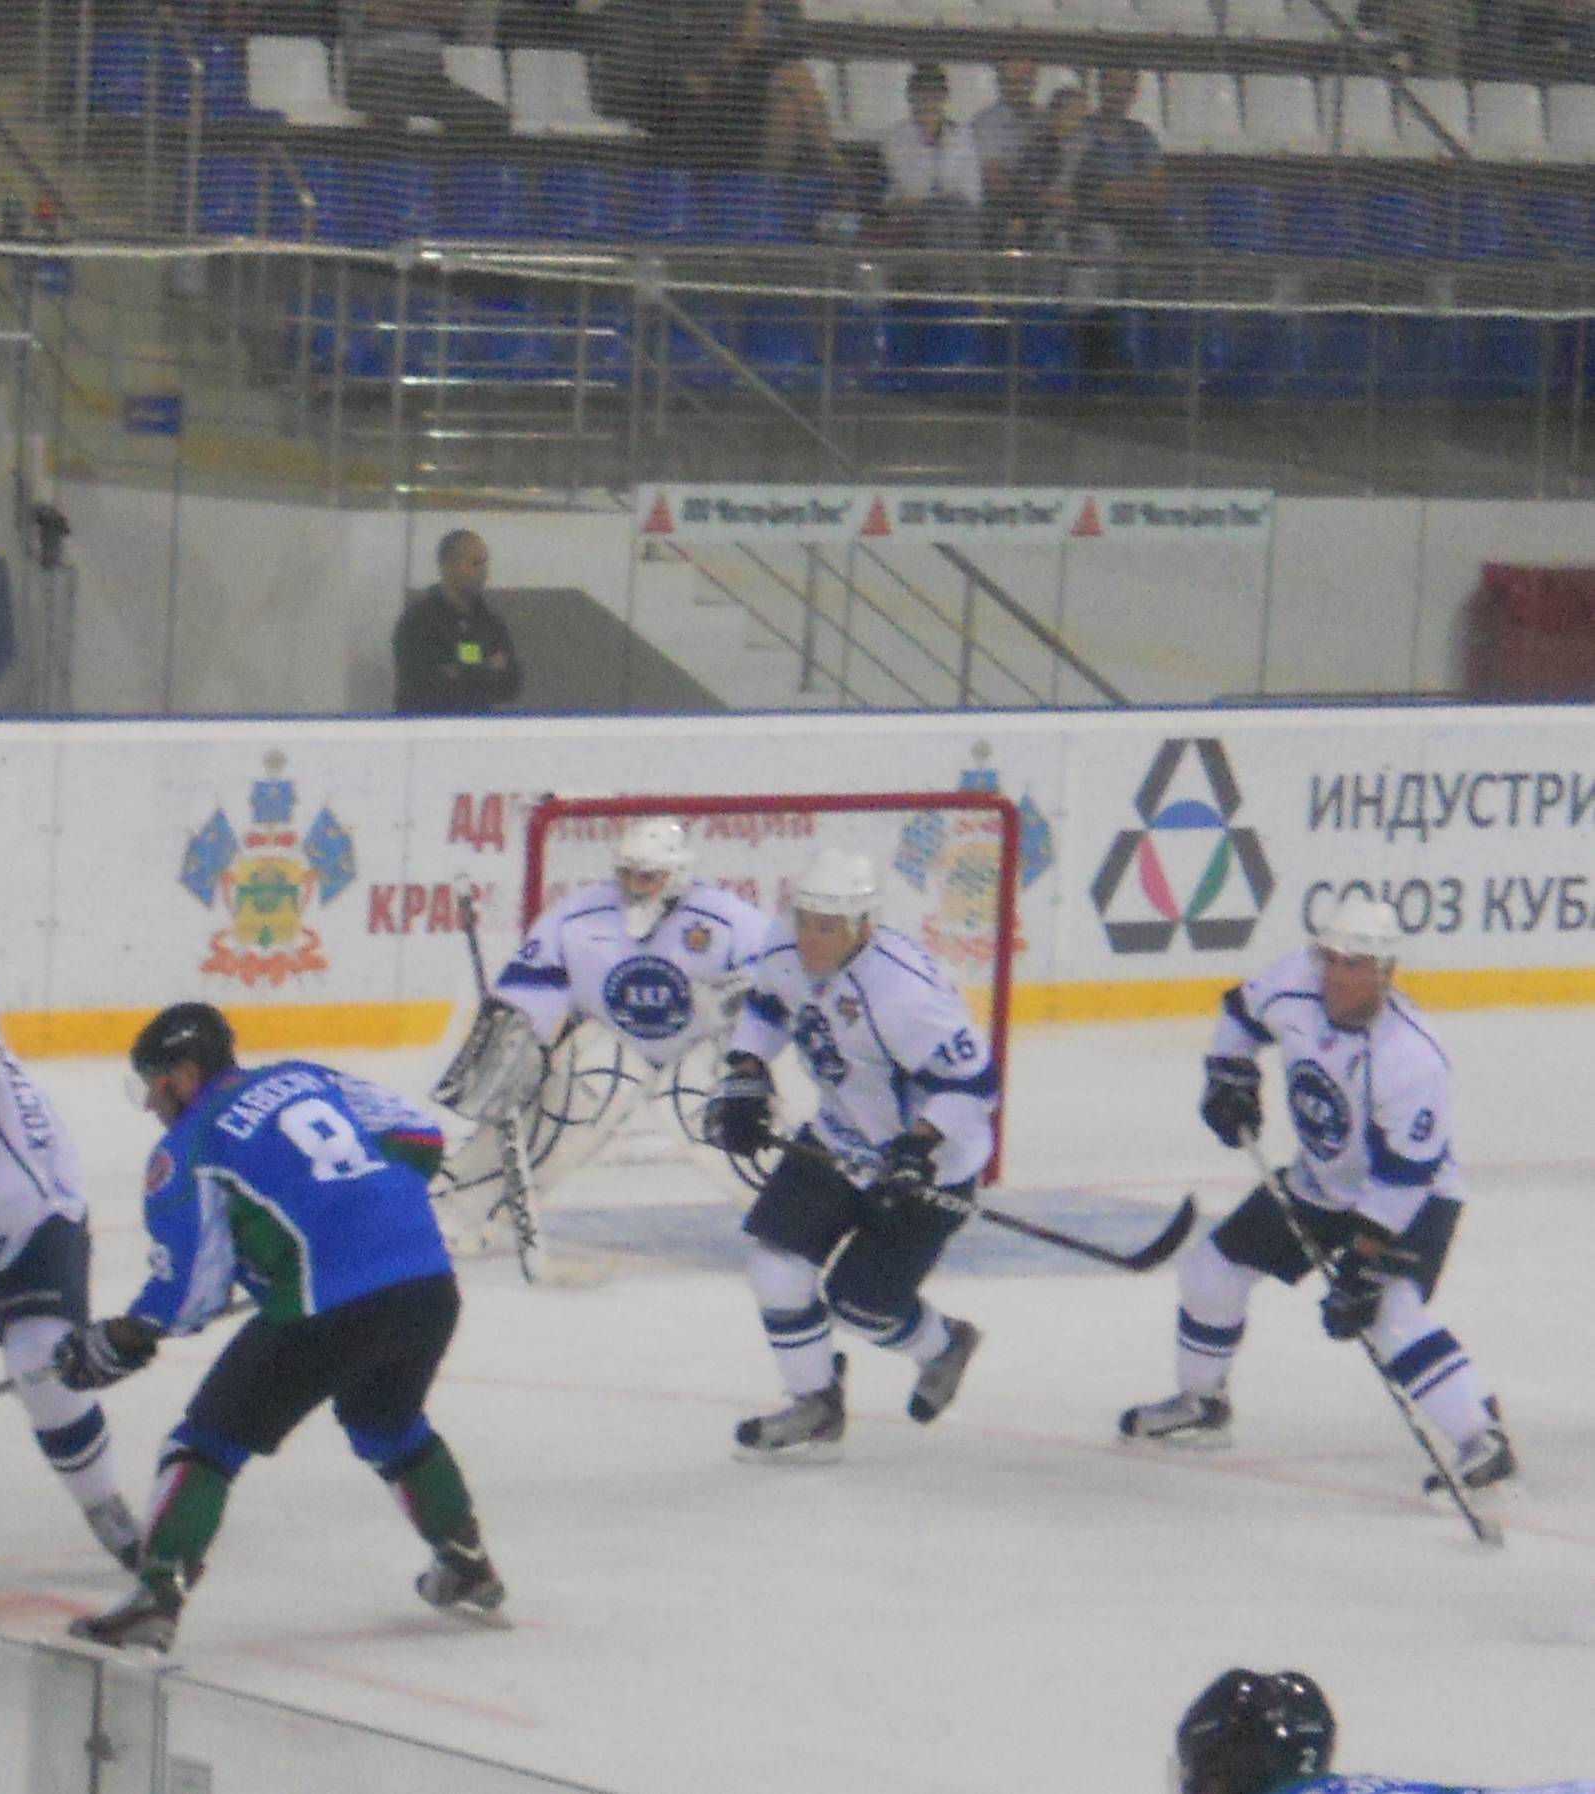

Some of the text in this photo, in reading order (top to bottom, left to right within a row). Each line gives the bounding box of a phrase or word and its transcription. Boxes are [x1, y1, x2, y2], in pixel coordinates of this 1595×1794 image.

[1307, 771, 1595, 844] ИНДУСТРИ
[1482, 875, 1595, 932] КУБ
[277, 1098, 389, 1182] 8
